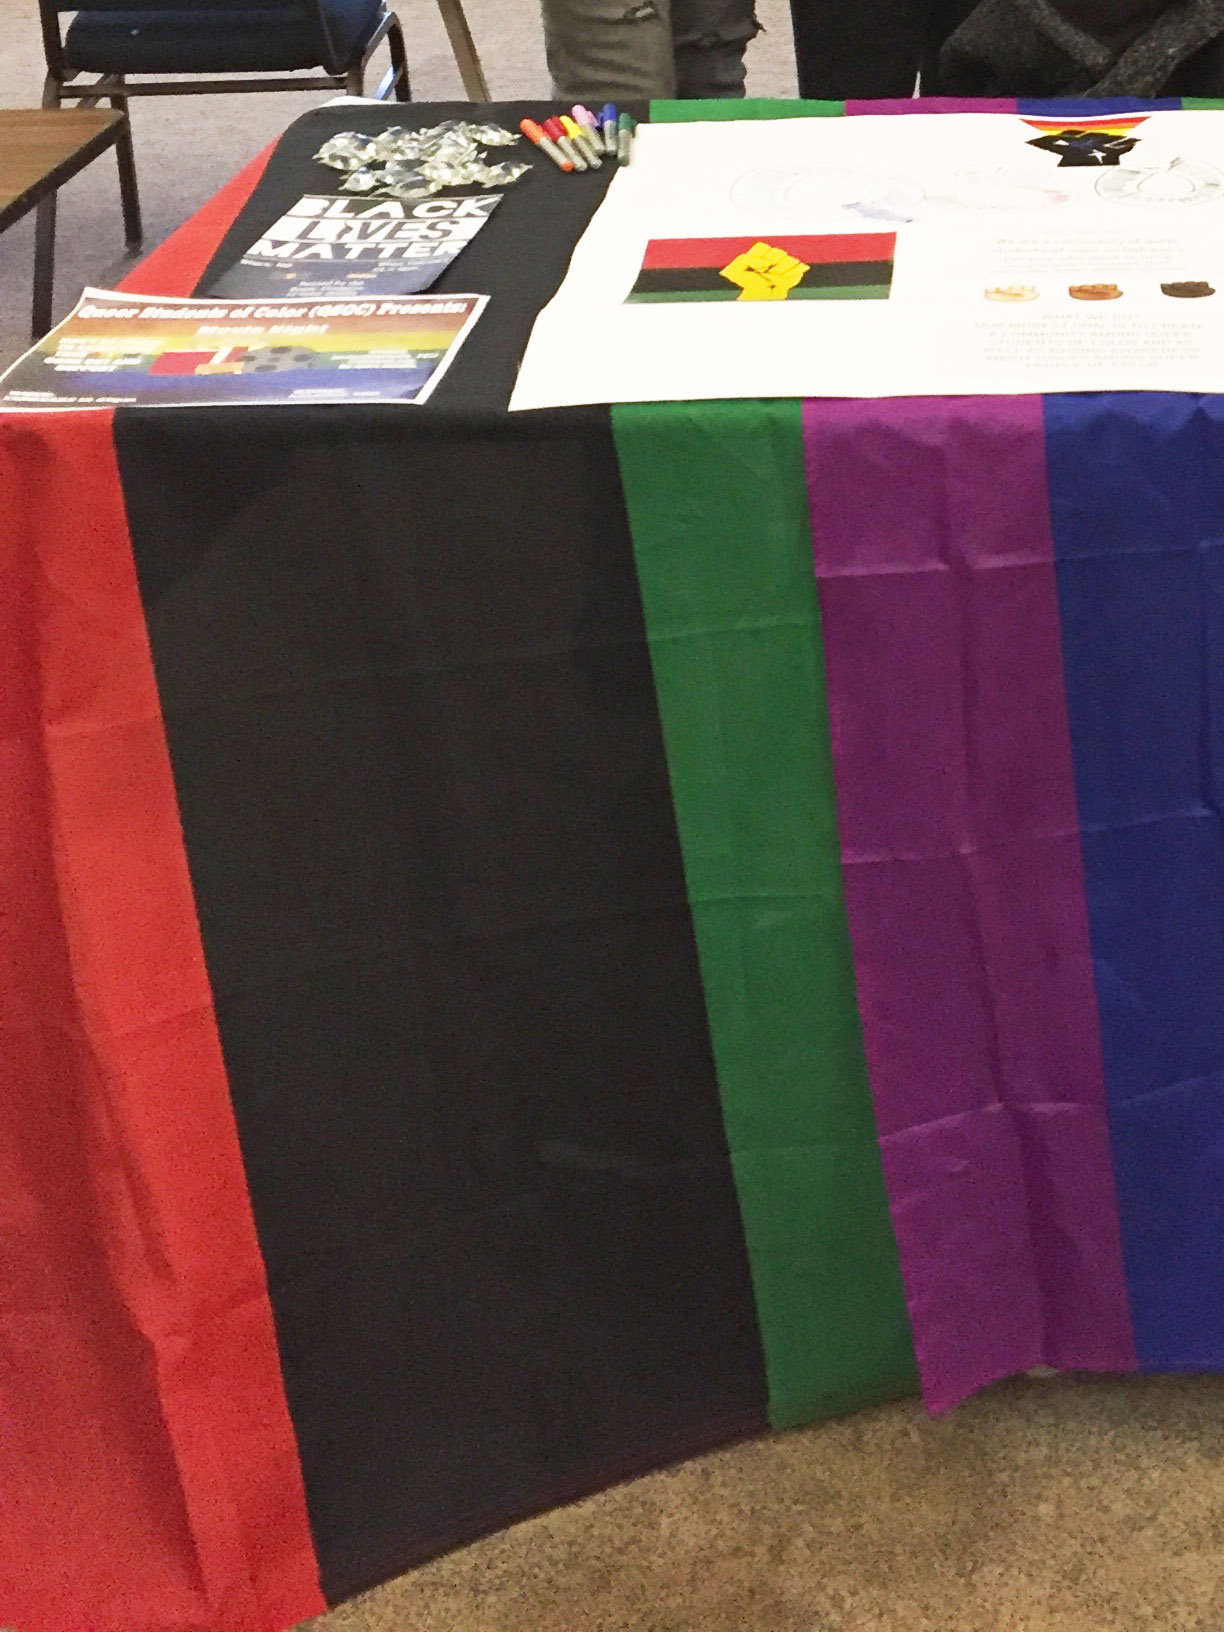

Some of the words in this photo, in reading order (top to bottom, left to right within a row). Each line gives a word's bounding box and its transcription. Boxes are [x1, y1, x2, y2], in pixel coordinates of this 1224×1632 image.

[285, 196, 500, 219] BLACK
[293, 218, 461, 242] LIVES
[248, 239, 467, 259] MATTER
[78, 304, 140, 319] Queer
[138, 306, 229, 319] Students
[229, 306, 255, 319] of
[253, 305, 308, 319] Color
[308, 302, 376, 319] (QSOC)
[377, 302, 468, 317] Presents:
